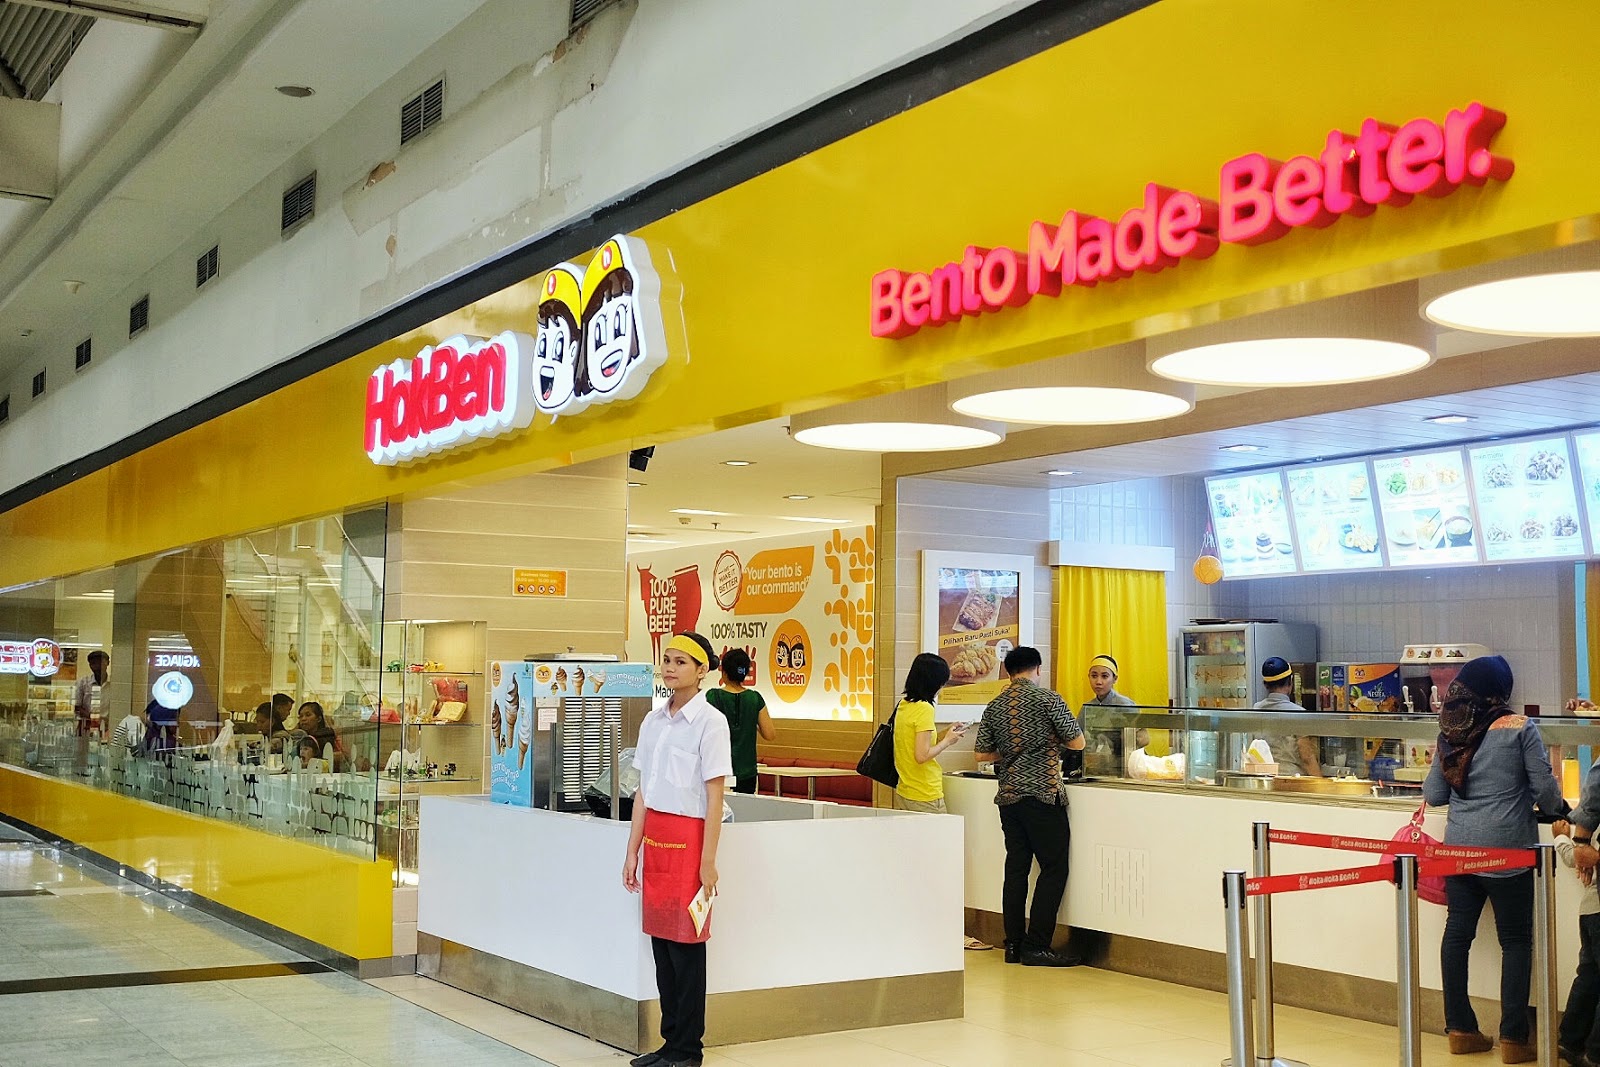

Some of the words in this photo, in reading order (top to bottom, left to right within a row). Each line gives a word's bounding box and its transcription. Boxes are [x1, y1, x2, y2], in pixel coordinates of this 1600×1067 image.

[871, 244, 1024, 339] Bento
[1028, 182, 1208, 295] Made
[1219, 102, 1502, 243] Better.
[364, 342, 507, 452] HokBen
[767, 565, 791, 579] bento
[794, 562, 802, 577] is
[649, 578, 677, 597] 100%
[718, 576, 739, 593] BETTER
[746, 584, 760, 596] our
[650, 596, 677, 615] PURE
[649, 614, 677, 633] BEEF
[710, 623, 736, 640] 100%
[736, 621, 768, 639] TASTY
[943, 636, 964, 646] Pilihan
[964, 634, 978, 642] Baru
[979, 631, 994, 639] Pasti
[775, 671, 805, 686] HokBen
